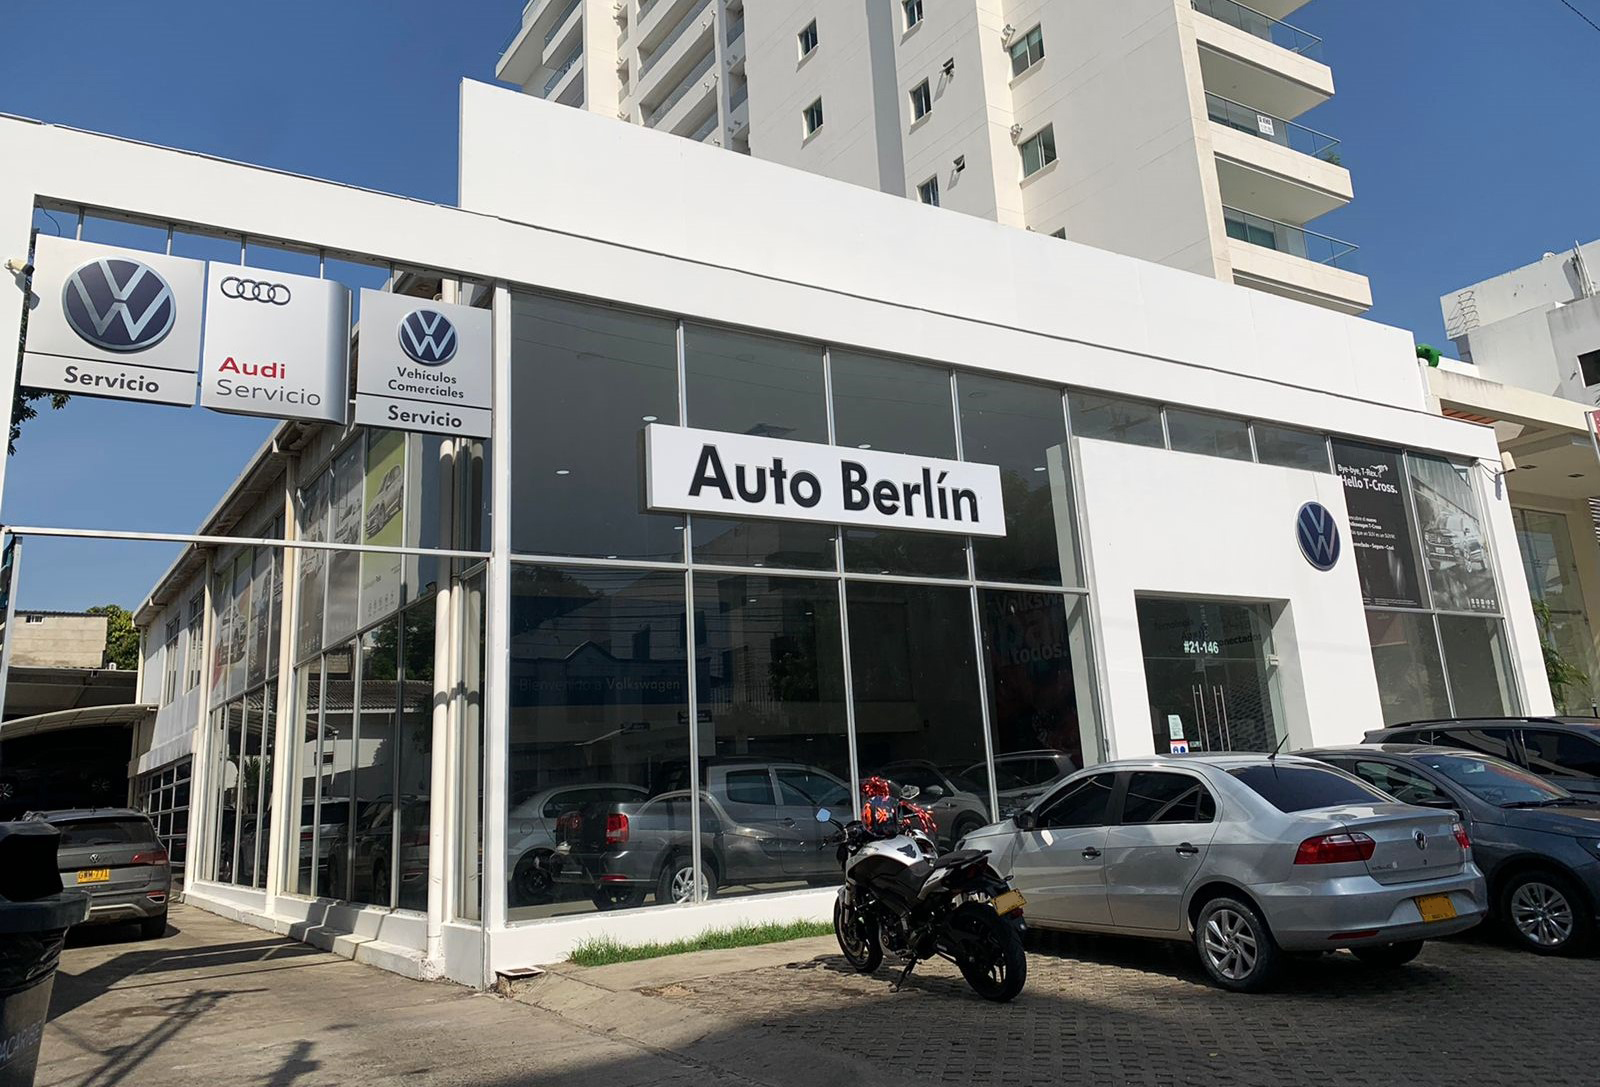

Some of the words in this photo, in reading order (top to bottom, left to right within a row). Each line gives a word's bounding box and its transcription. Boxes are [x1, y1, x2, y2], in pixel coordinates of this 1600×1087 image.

[218, 356, 286, 379] Audi
[397, 366, 457, 385] Vehículos
[64, 365, 159, 393] Servicio
[388, 379, 464, 399] Comerciales
[216, 378, 321, 406] Servicio
[388, 404, 462, 428] Servicio
[687, 443, 822, 508] Auto
[840, 459, 979, 522] Berlín
[1341, 474, 1363, 488] Hello
[1363, 478, 1398, 494] T-Cross.
[1183, 640, 1219, 655] #21-146
[605, 676, 680, 693] Volkswagen
